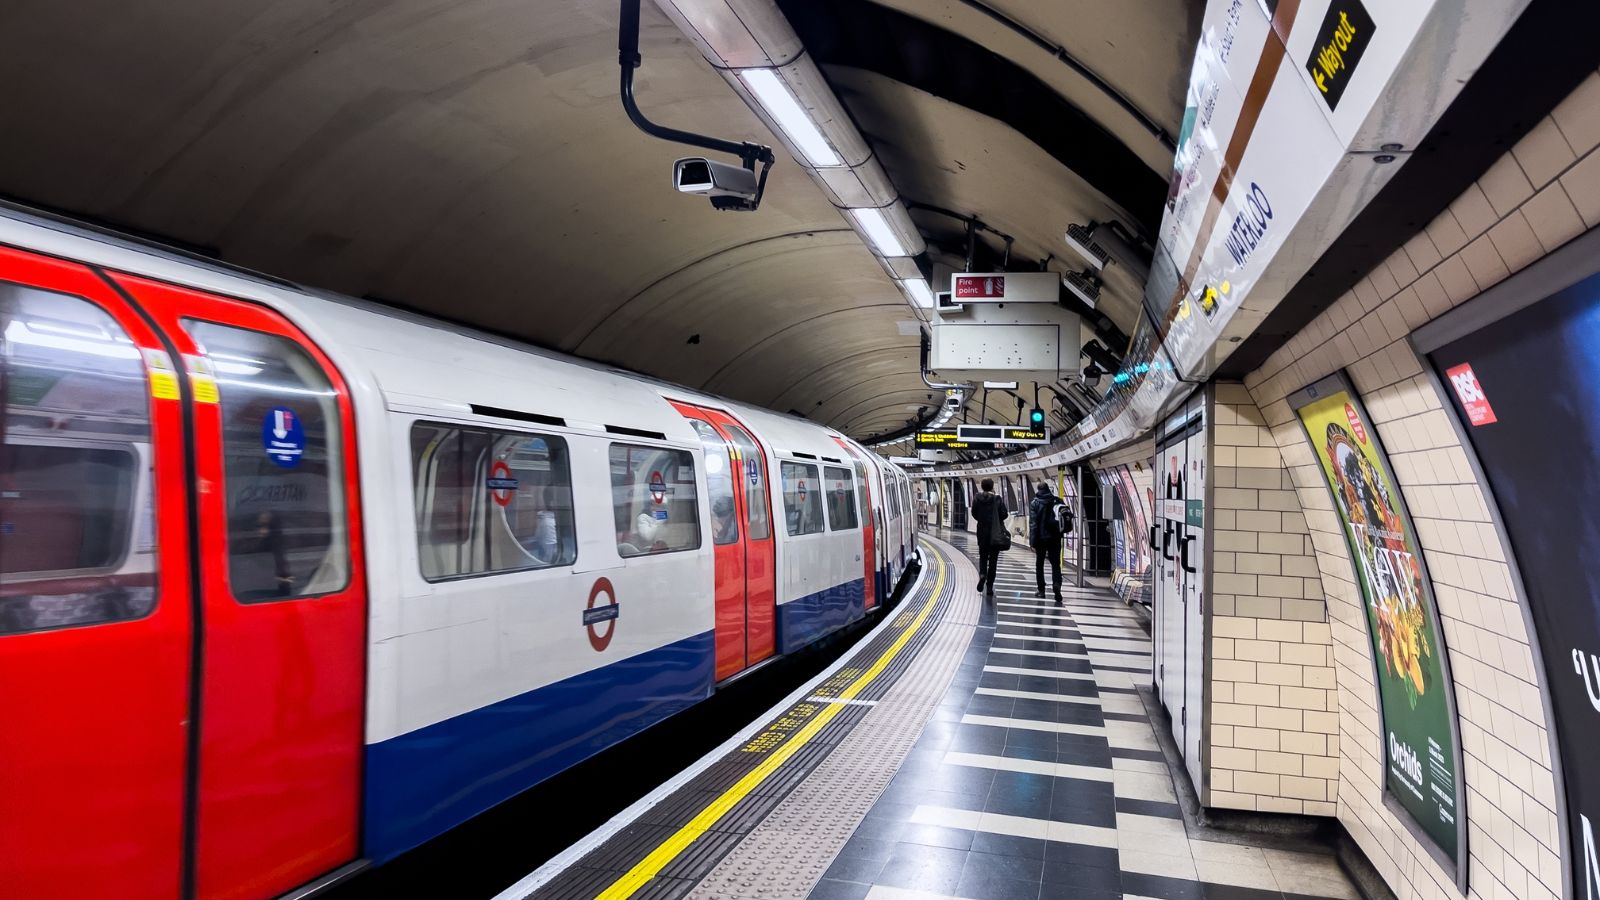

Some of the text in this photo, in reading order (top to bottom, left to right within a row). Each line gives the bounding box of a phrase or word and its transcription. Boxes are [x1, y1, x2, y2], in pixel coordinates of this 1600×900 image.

[1317, 10, 1355, 79] Way out
[1225, 182, 1273, 269] WATERLOO
[959, 286, 978, 295] point
[1450, 370, 1485, 404] RSC
[1012, 430, 1025, 438] Way
[1390, 731, 1422, 786] Orchids
